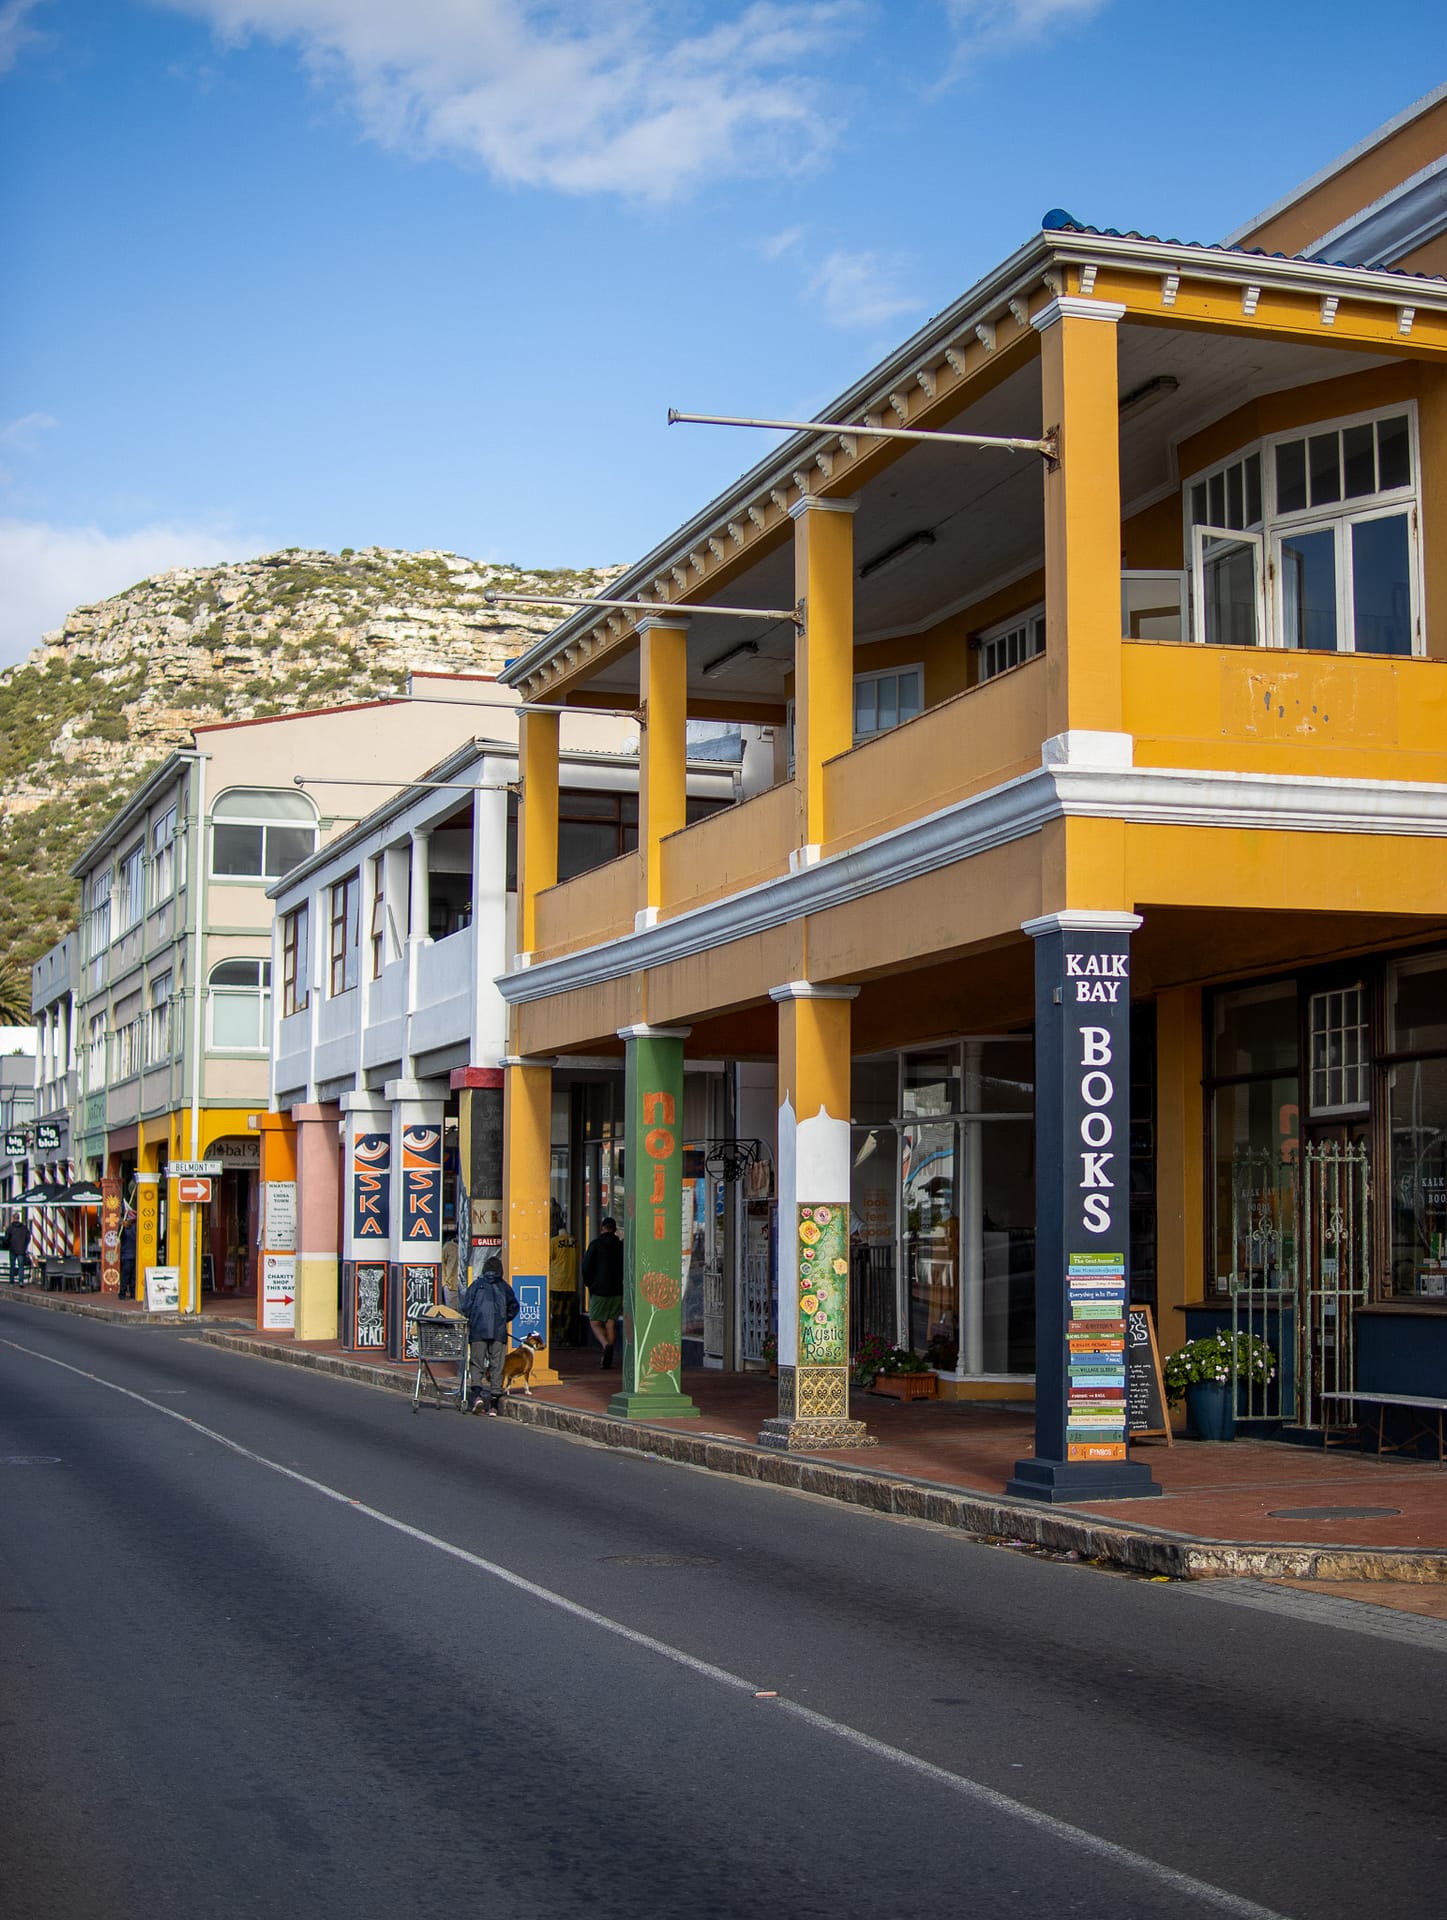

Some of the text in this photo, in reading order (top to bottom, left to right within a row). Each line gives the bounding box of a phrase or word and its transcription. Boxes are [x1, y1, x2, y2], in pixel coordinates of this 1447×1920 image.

[1066, 954, 1128, 976] KALK
[1076, 981, 1120, 1002] BAY
[40, 1127, 56, 1138] big
[1079, 1026, 1114, 1233] BOOKS
[6, 1145, 25, 1154] blue
[8, 1136, 23, 1147] big
[38, 1138, 59, 1148] blue
[175, 1162, 208, 1172] BELMONT
[643, 1091, 675, 1240] noji
[1421, 1176, 1445, 1187] KALK
[358, 1326, 384, 1346] PEACE
[802, 1325, 844, 1346] Mystic
[804, 1343, 842, 1361] Rose
